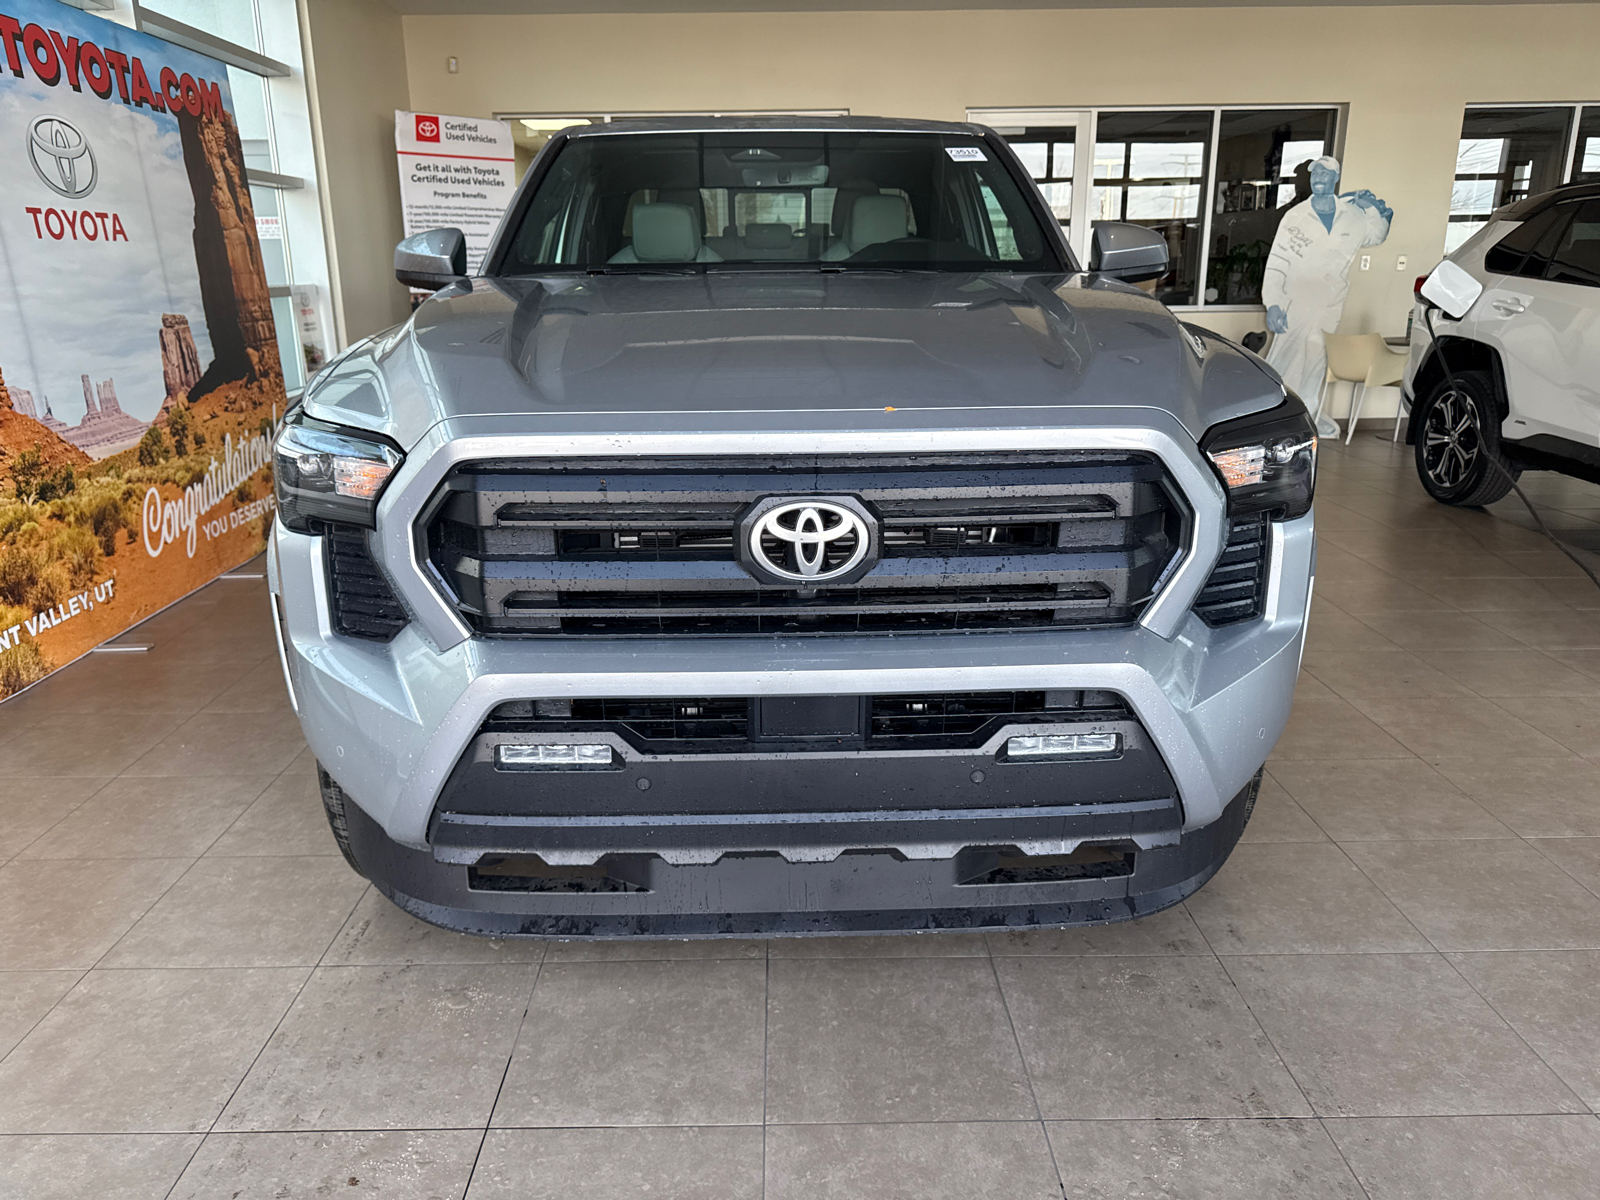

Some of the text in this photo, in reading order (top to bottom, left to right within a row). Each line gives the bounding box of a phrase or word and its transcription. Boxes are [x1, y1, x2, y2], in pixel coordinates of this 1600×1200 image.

[444, 122, 478, 132] Certified
[446, 132, 497, 144] Used Vehicles
[415, 163, 500, 176] Get it all with Toyota
[411, 174, 505, 187] Certified Used Vehicles
[433, 190, 487, 200] Program Benefits
[25, 206, 129, 242] TOYOTA
[202, 493, 276, 541] YOU DESERVE
[24, 591, 94, 637] VALLEY,
[94, 579, 114, 602] UT
